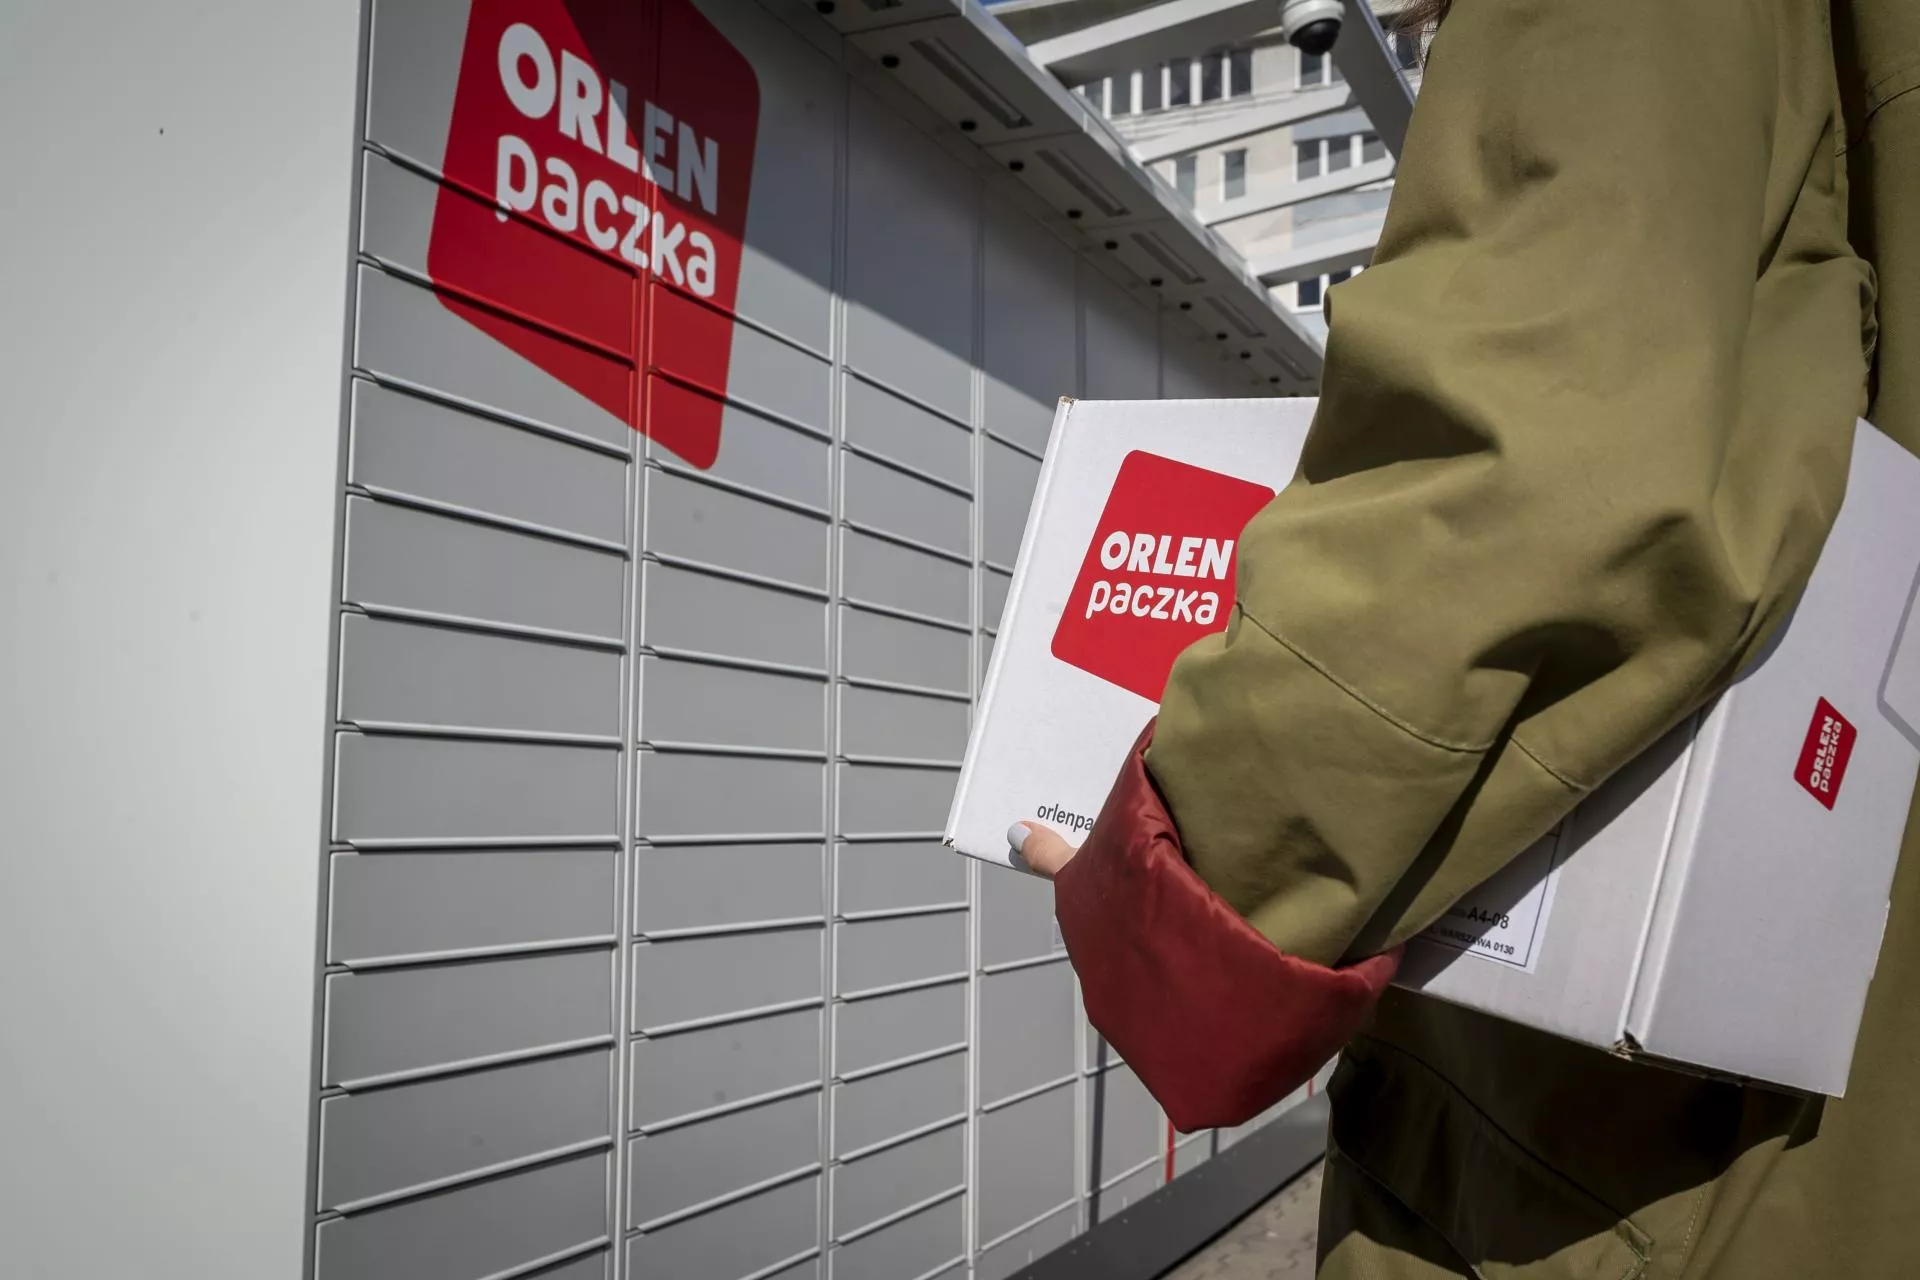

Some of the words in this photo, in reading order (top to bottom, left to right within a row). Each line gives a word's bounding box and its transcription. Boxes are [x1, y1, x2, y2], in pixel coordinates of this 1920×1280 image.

[498, 22, 718, 216] ORLEN
[496, 134, 716, 297] paczka
[1100, 530, 1234, 580] ORLEN
[1085, 580, 1219, 625] paczka
[1810, 715, 1834, 788] ORLEN
[1820, 721, 1842, 793] paczka
[1440, 928, 1491, 949] WARSZAWA
[1493, 942, 1515, 955] 0130
[1467, 906, 1510, 929] A4-08
